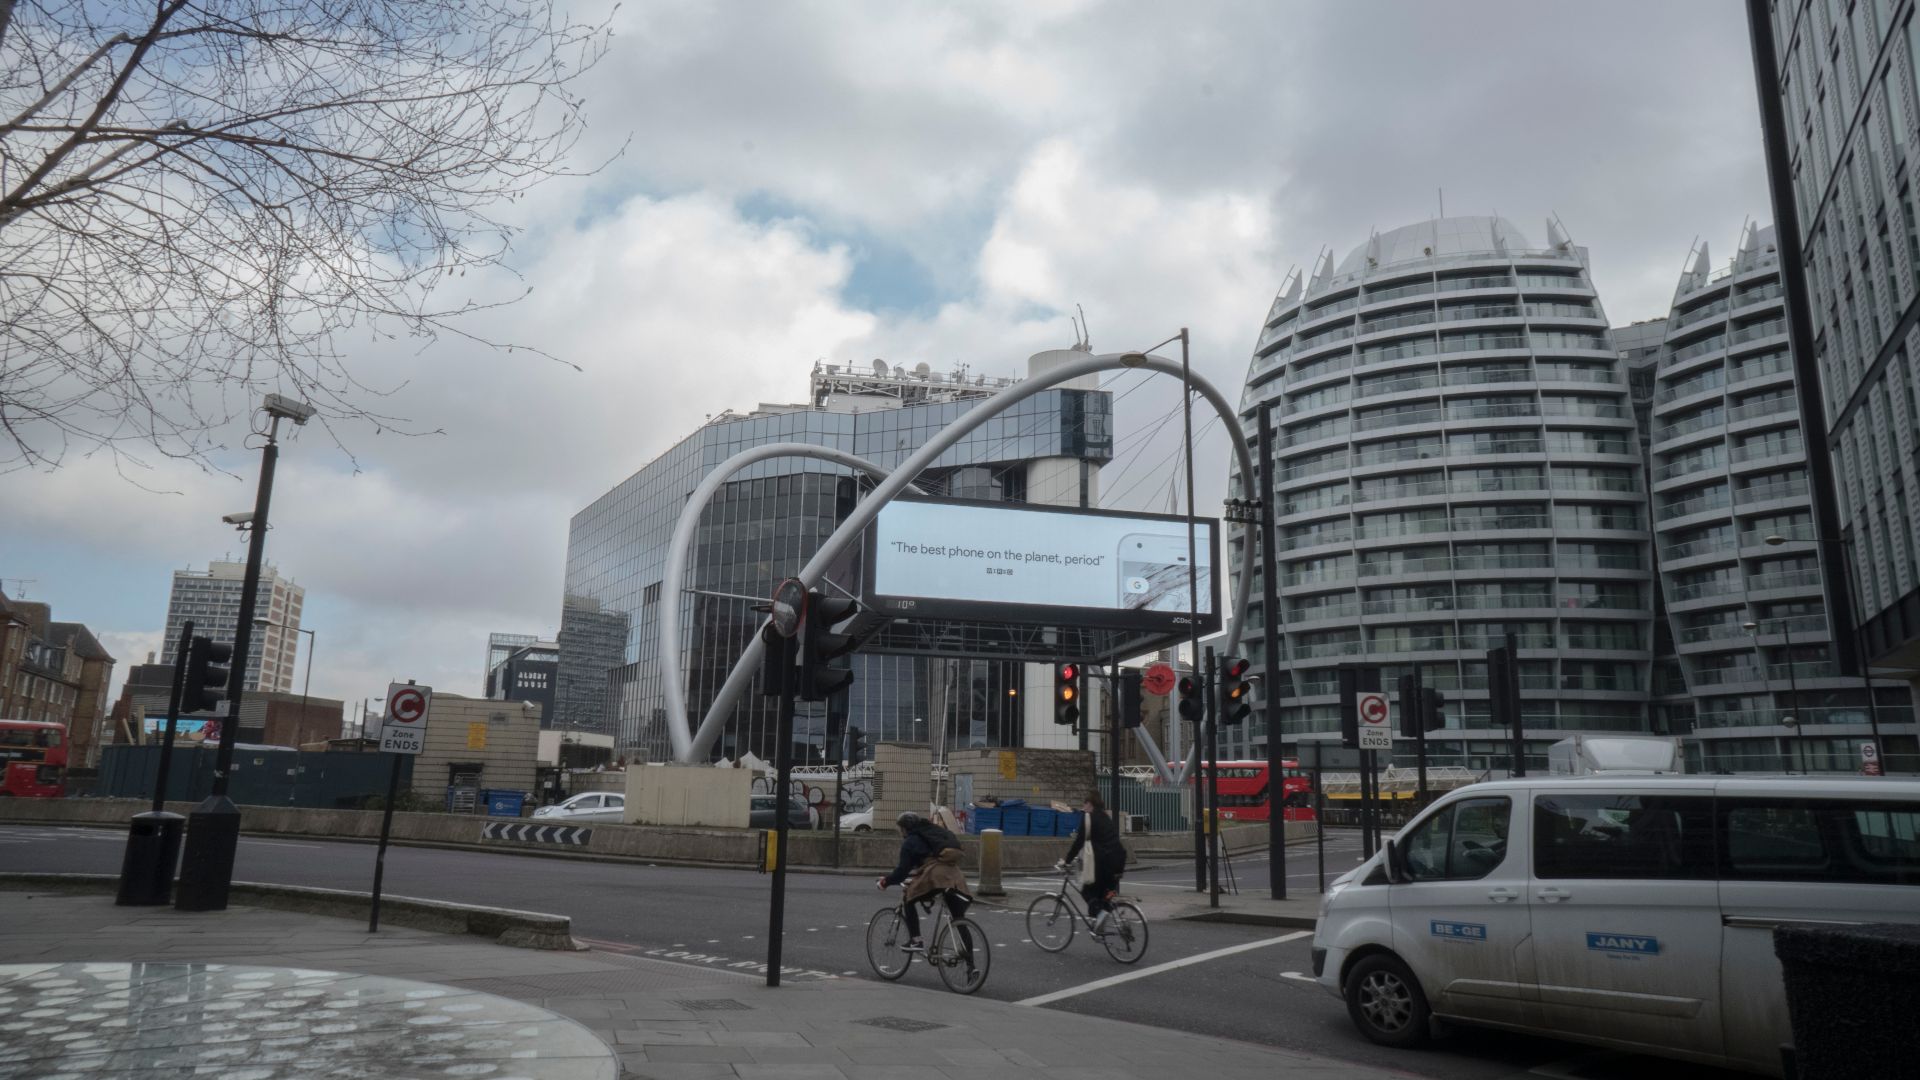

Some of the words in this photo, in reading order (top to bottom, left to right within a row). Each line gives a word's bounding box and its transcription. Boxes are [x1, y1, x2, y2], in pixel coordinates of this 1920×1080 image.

[920, 543, 947, 556] best
[948, 546, 985, 562] phone
[986, 550, 1002, 560] on
[1004, 548, 1022, 561] the
[1024, 550, 1063, 565] planet,
[1172, 617, 1202, 625] JCDecx
[392, 729, 415, 739] Zone
[1366, 729, 1384, 737] Zone
[384, 739, 420, 751] ENDS
[1362, 737, 1390, 746] ENDS
[1594, 936, 1649, 950] JANY
[644, 948, 729, 964] LOOK
